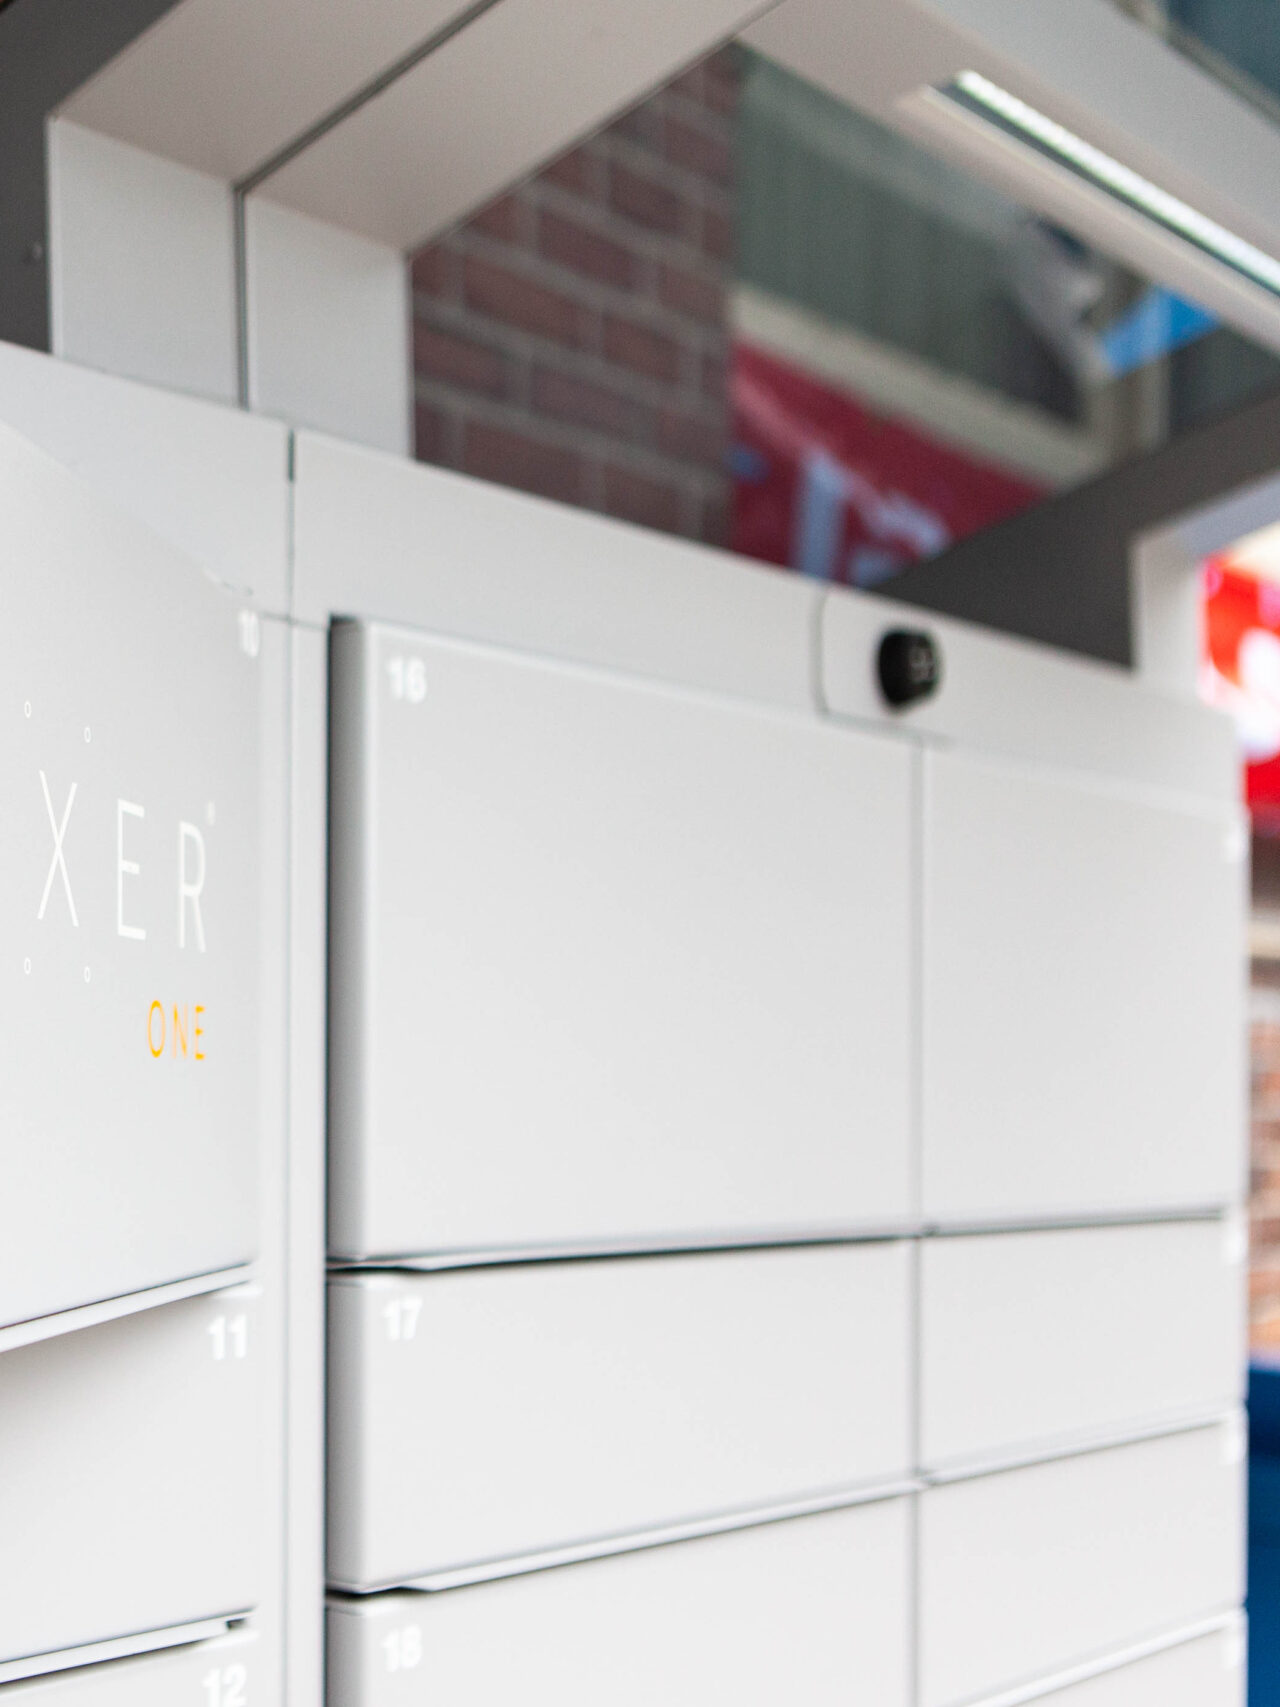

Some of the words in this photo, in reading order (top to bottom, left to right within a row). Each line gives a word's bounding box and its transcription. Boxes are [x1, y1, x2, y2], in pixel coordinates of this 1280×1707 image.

[384, 655, 428, 704] 16
[147, 999, 206, 1060] ONE
[207, 1314, 248, 1360] 11
[380, 1294, 423, 1341] 17
[201, 1663, 248, 1707] 12
